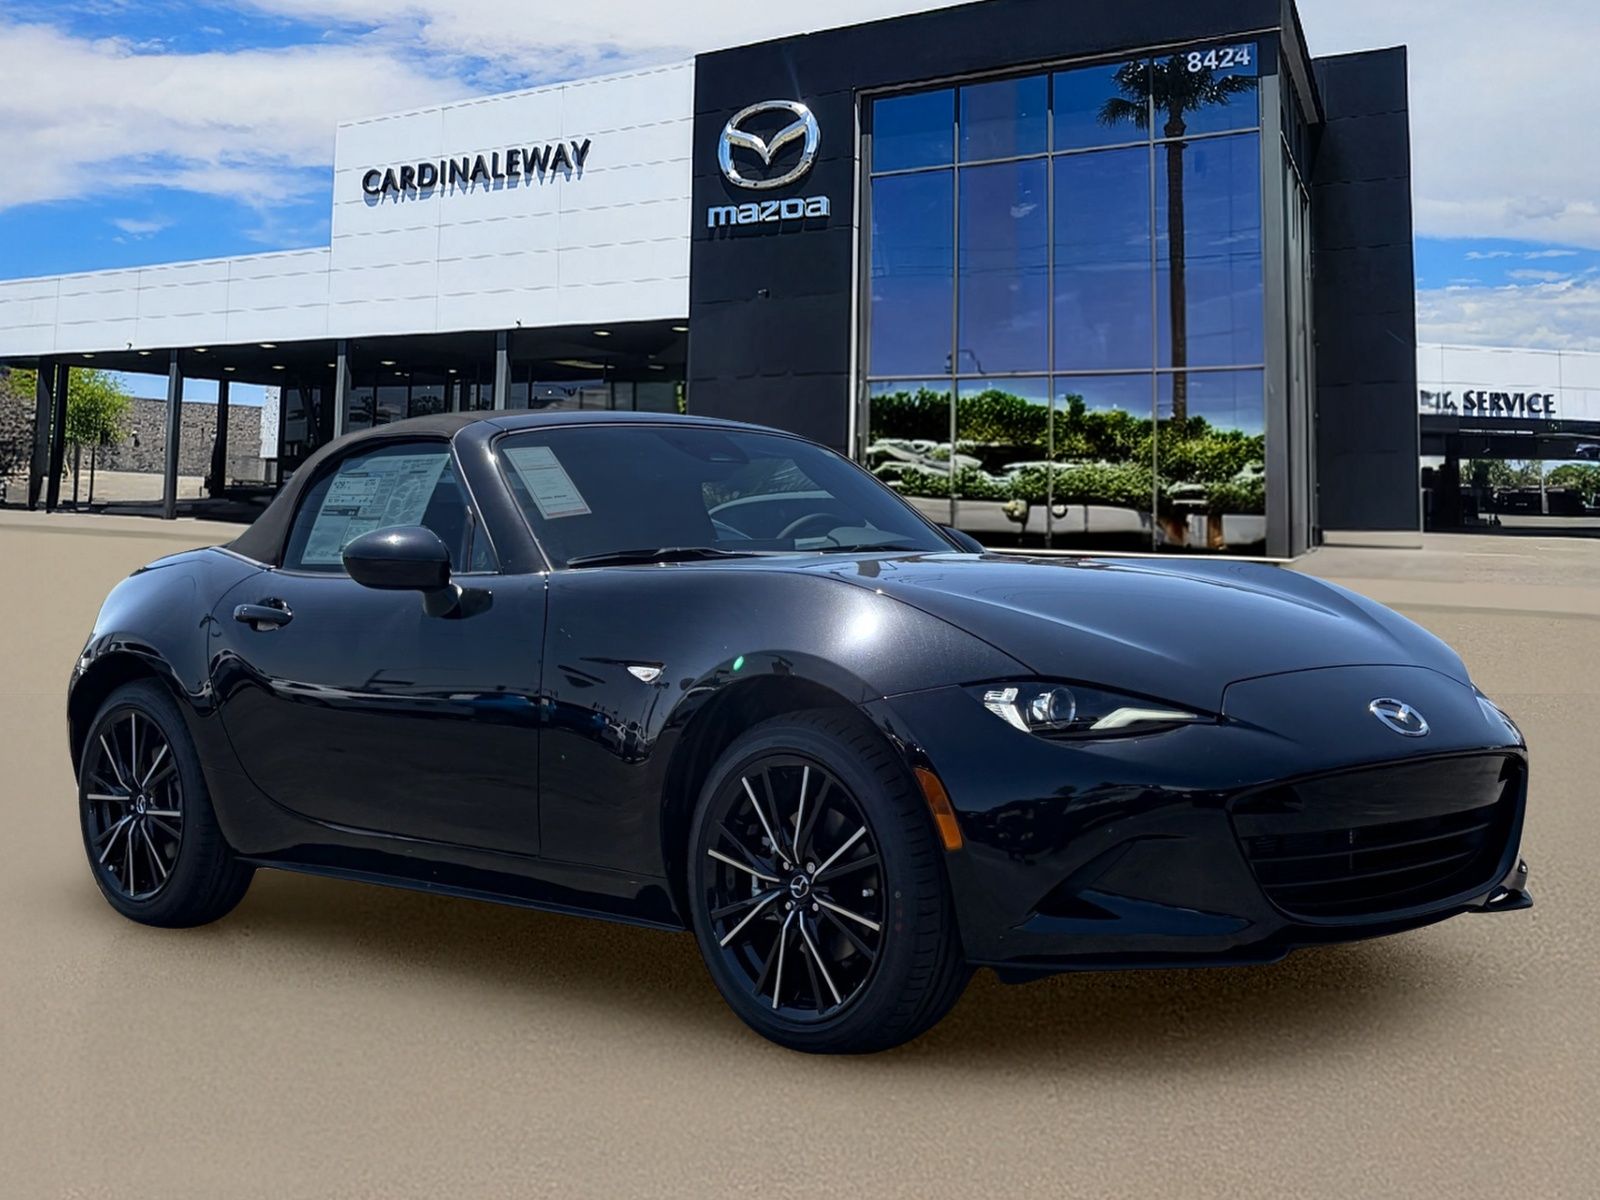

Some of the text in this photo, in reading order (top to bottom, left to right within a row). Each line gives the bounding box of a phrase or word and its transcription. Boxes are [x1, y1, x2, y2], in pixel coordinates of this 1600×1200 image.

[1187, 46, 1251, 72] 8424
[362, 138, 592, 195] CARDINALEWAY
[707, 195, 831, 228] mazda
[1463, 390, 1556, 414] SERVICE
